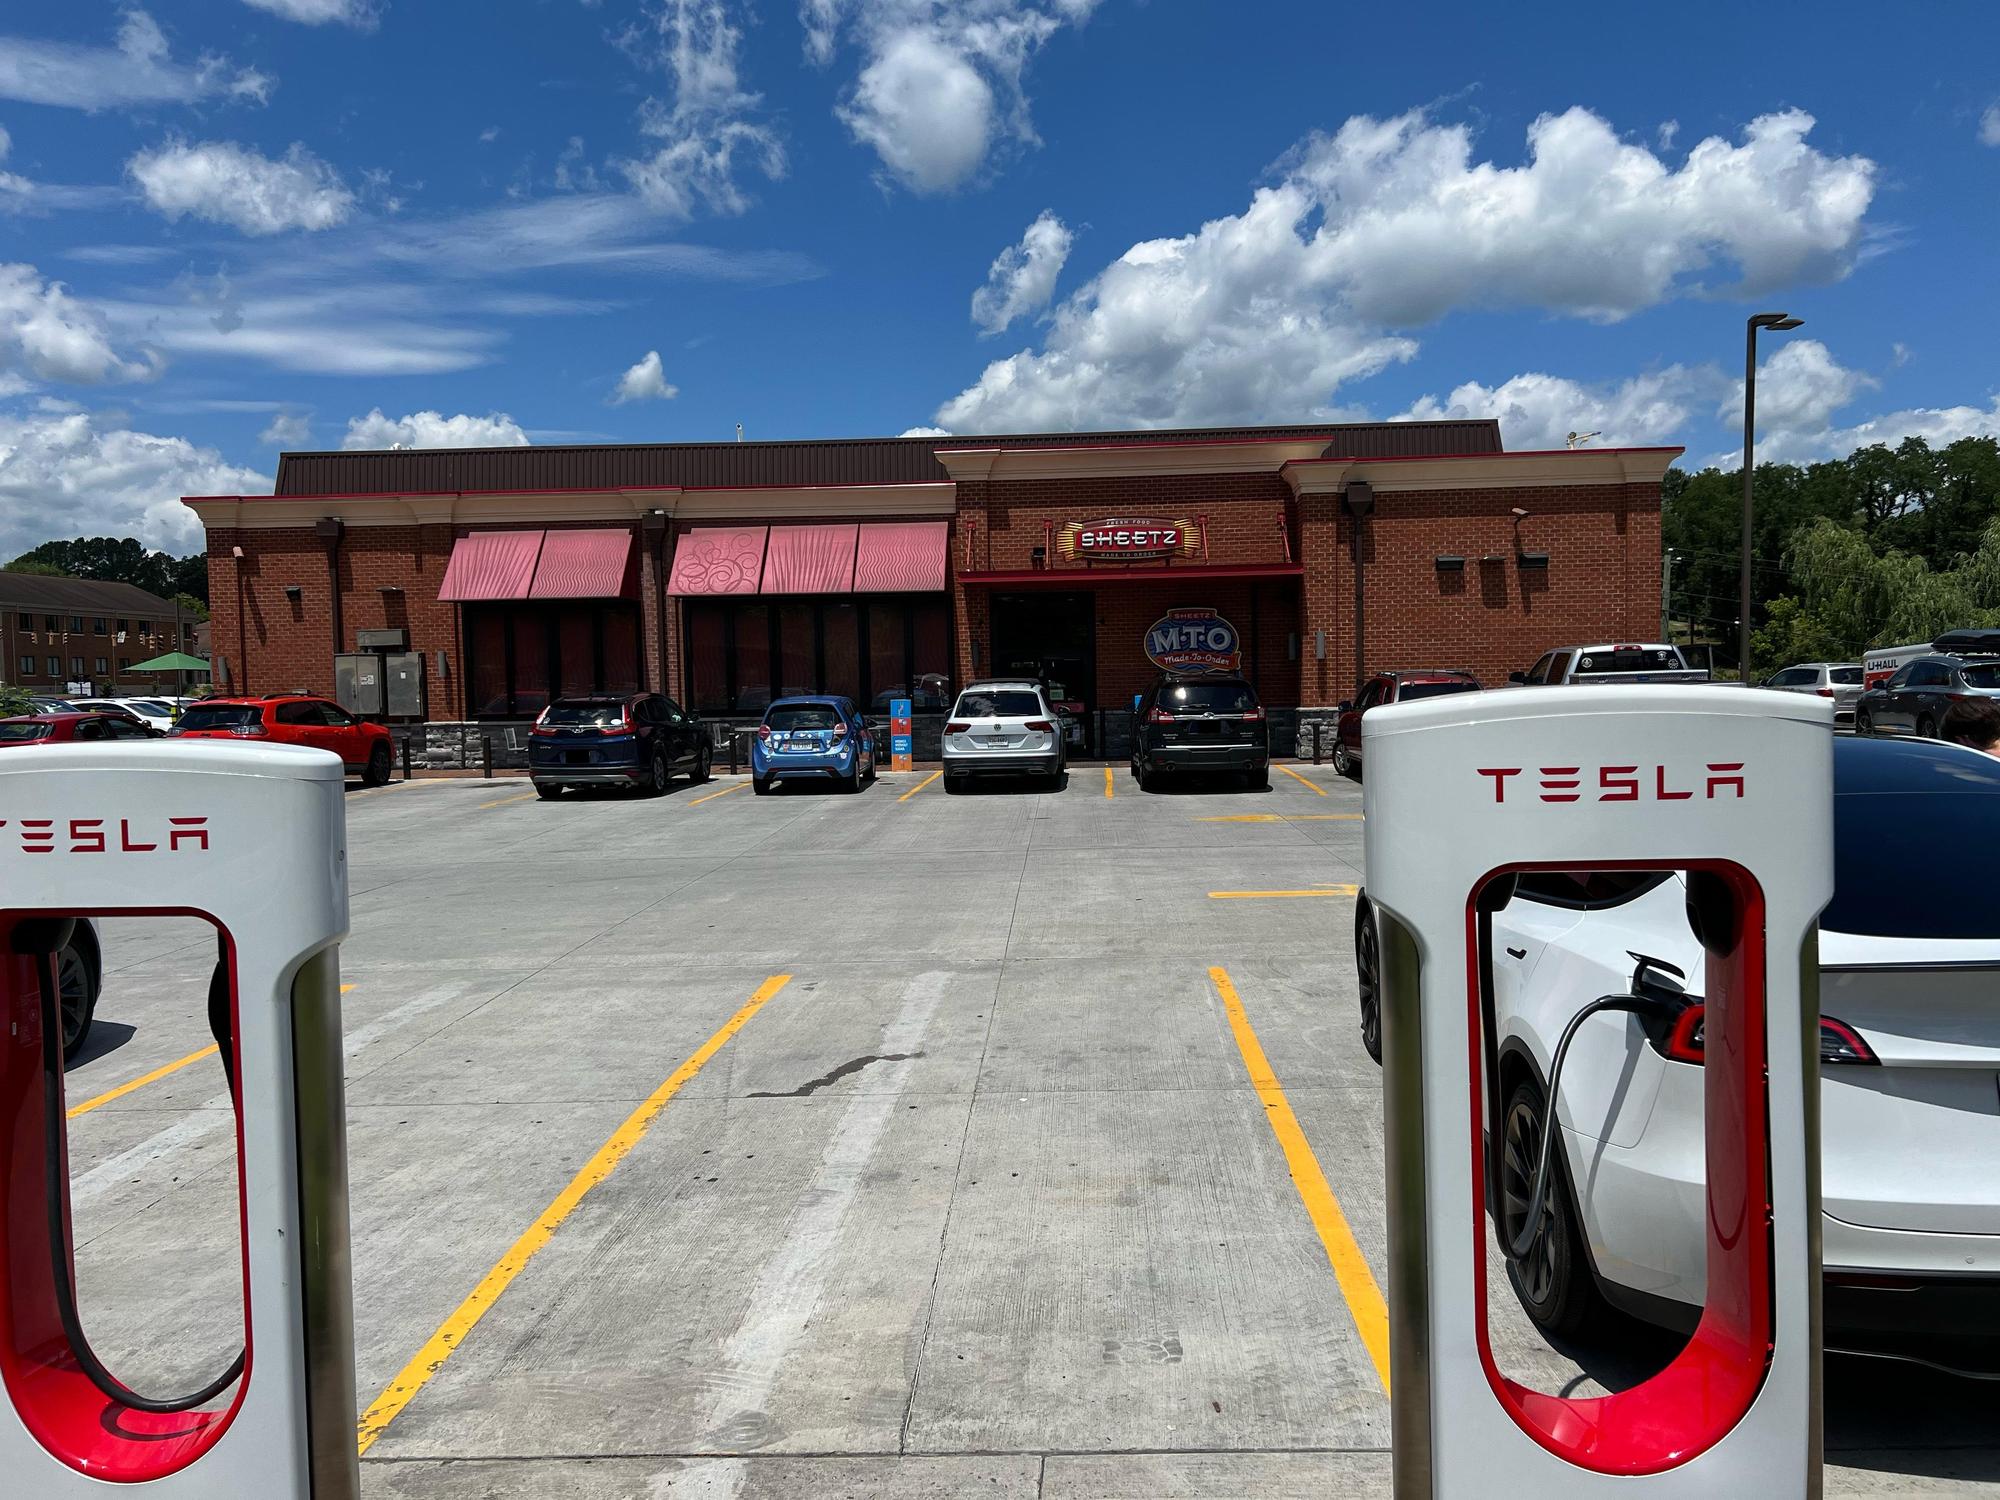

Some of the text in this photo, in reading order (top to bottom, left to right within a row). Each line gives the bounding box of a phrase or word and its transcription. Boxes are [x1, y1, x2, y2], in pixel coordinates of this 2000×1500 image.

[1081, 531, 1176, 546] SHEETZ
[1867, 659, 1899, 671] U-HAUL
[1477, 762, 1745, 803] TESLA
[0, 816, 209, 853] ESLA
